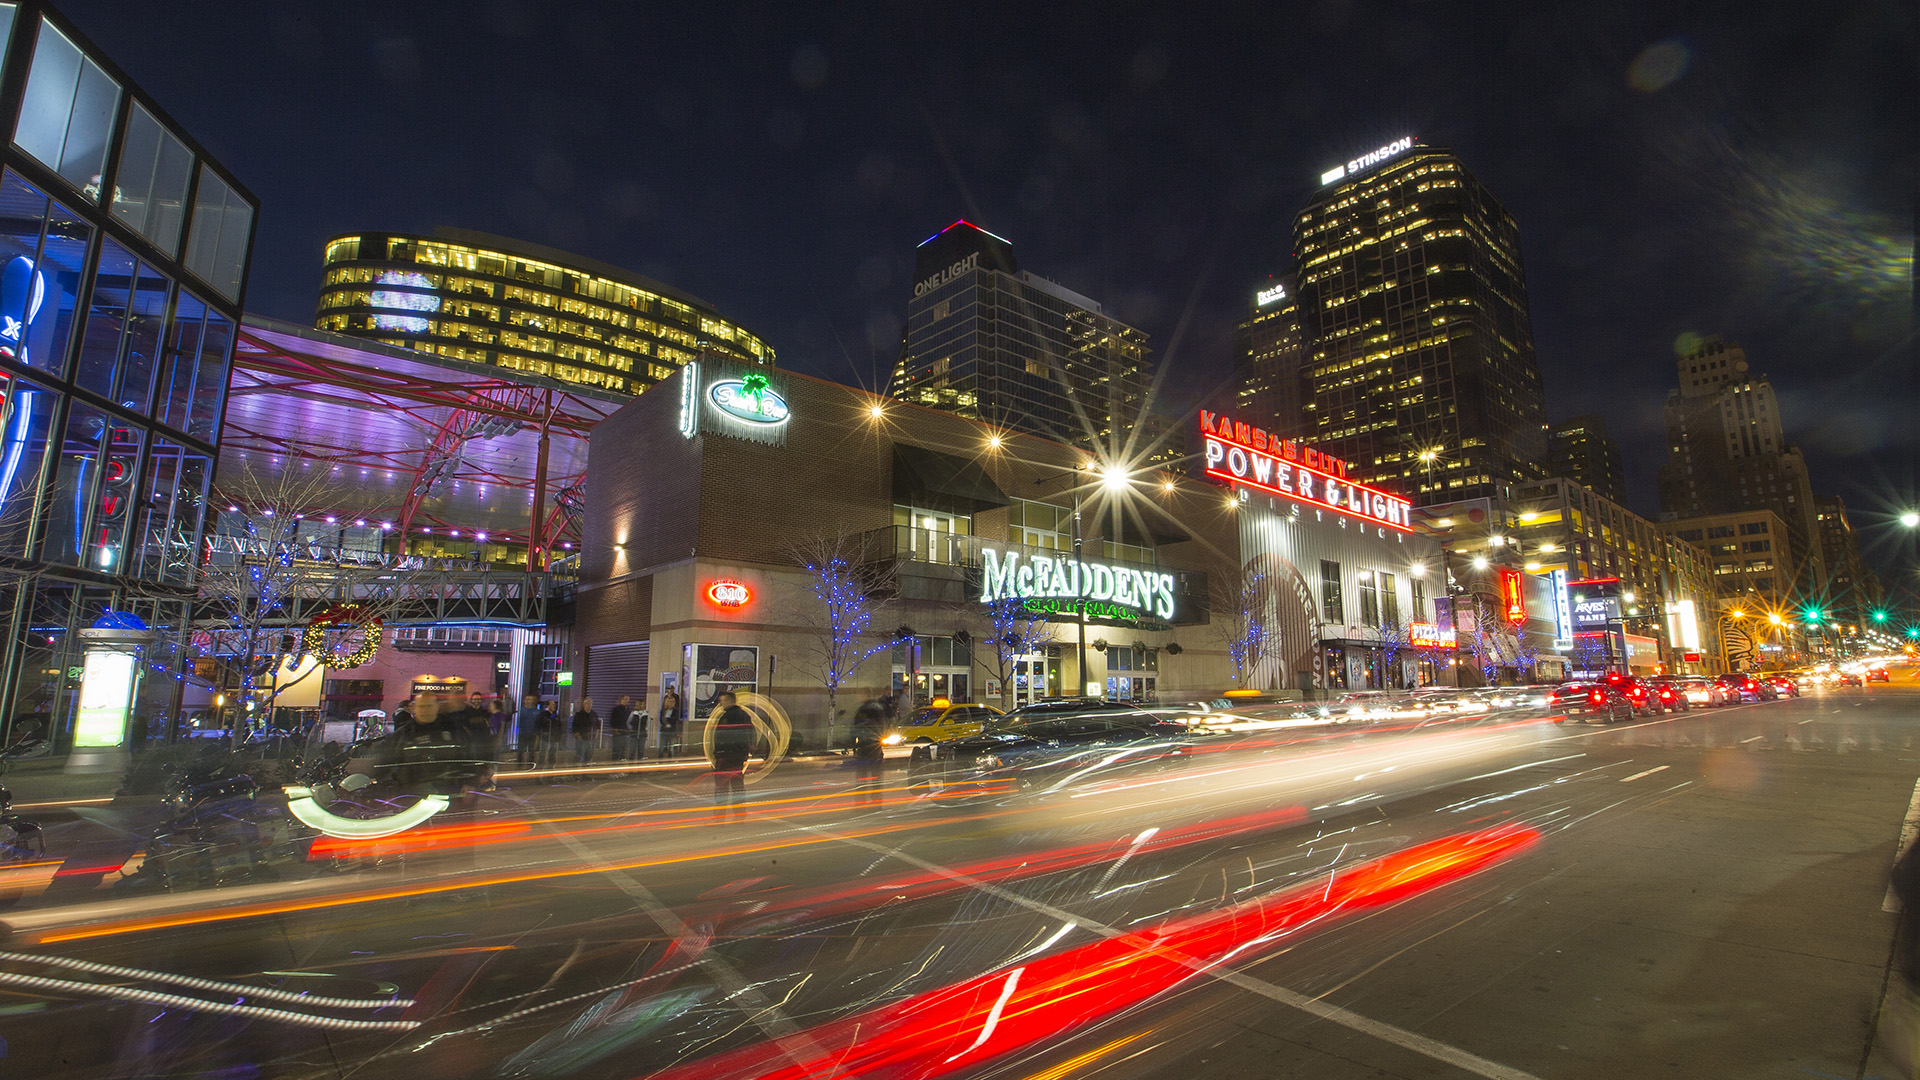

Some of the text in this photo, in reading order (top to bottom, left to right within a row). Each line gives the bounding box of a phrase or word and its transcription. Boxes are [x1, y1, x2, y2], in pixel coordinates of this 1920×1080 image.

[1347, 136, 1411, 173] STINSON
[914, 251, 979, 297] ONE LIGHT
[1200, 409, 1348, 478] KANSAS CITY
[1206, 438, 1411, 527] POWER & LIGHT
[1240, 488, 1404, 544] DISTRICT
[715, 586, 746, 601] 810
[1293, 575, 1313, 616] THE
[1308, 616, 1323, 690] MOON
[1412, 625, 1440, 640] PIZZA
[1577, 613, 1607, 622] BANK
